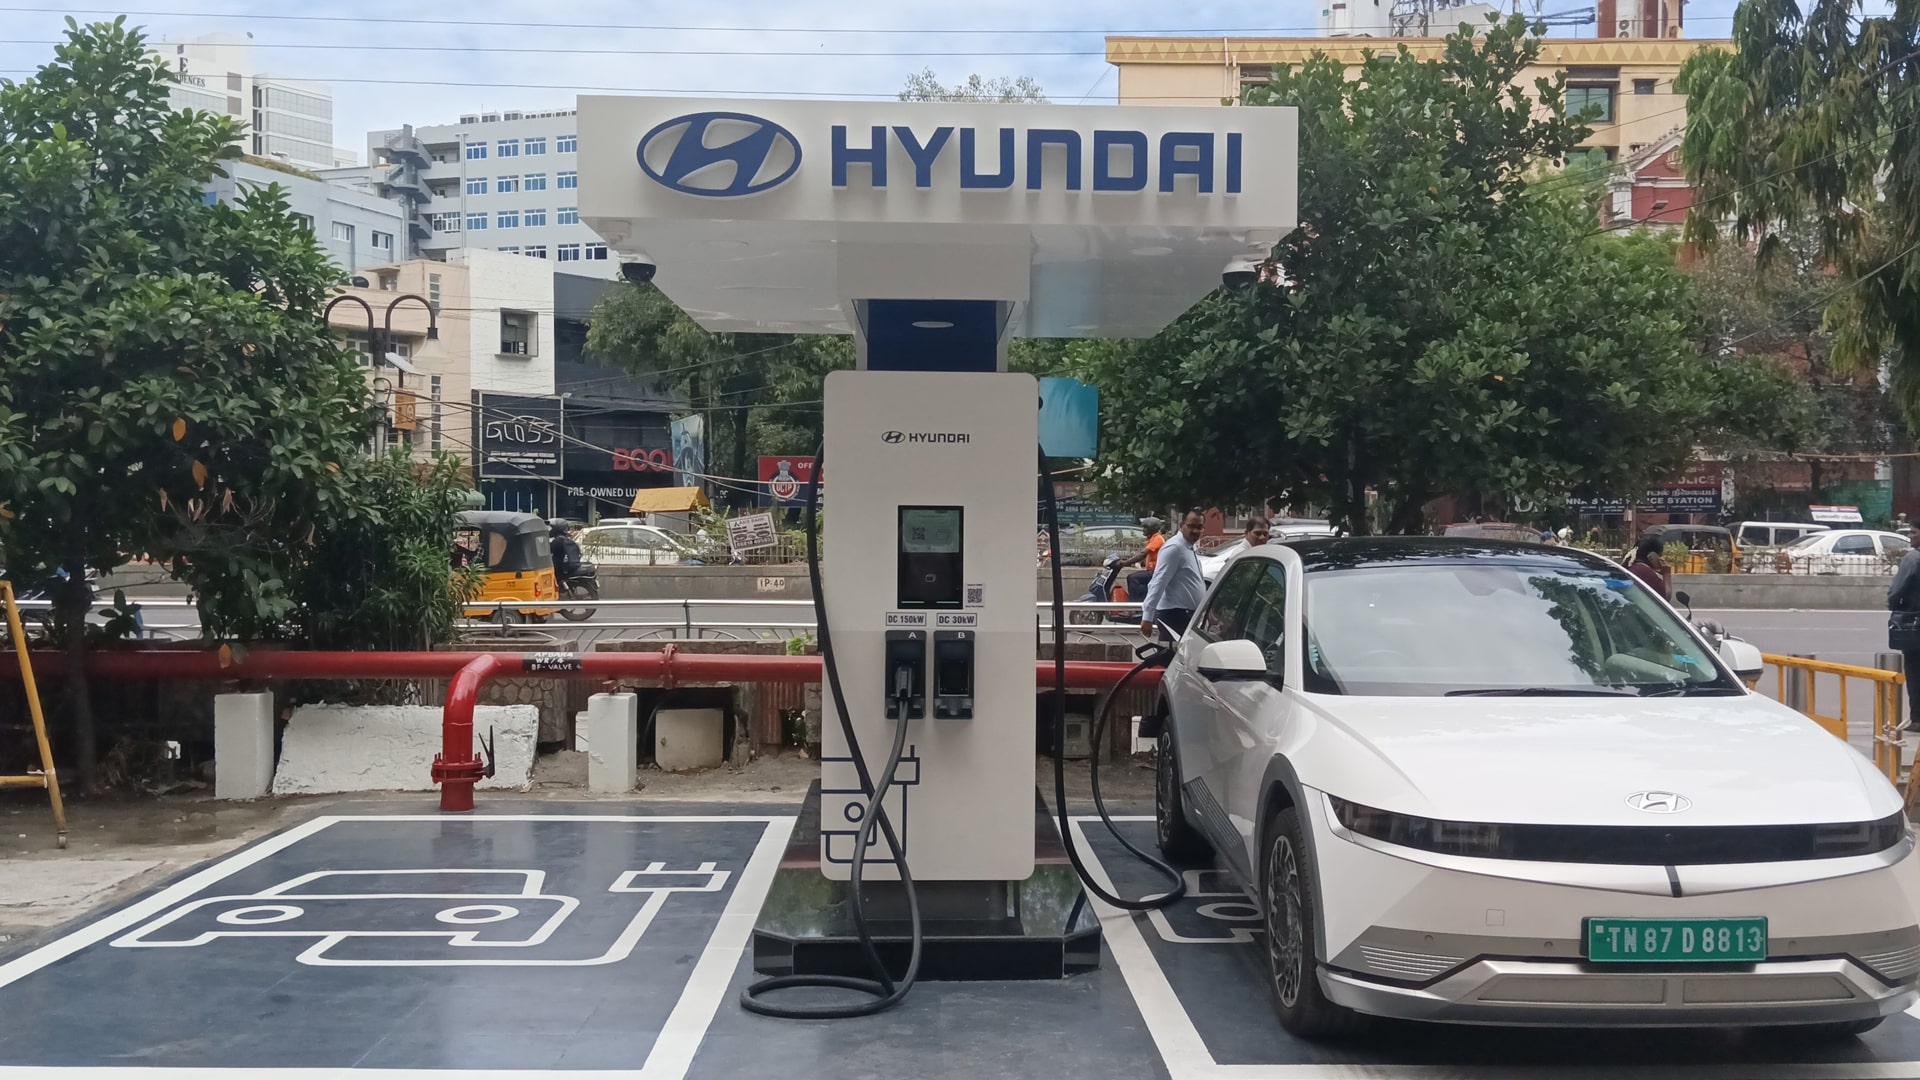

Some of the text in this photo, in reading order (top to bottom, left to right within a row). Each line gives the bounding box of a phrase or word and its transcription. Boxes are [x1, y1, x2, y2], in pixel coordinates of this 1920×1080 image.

[832, 125, 1242, 193] HYUNDAI
[486, 420, 554, 444] GLOSS
[909, 432, 970, 443] HYUNDAI
[1667, 496, 1713, 505] STATION
[888, 615, 925, 624] DC 150kW
[939, 615, 975, 624] DC 30kW
[908, 631, 917, 639] A
[958, 631, 965, 639] B
[1608, 926, 1762, 953] TN 87 D 8813
